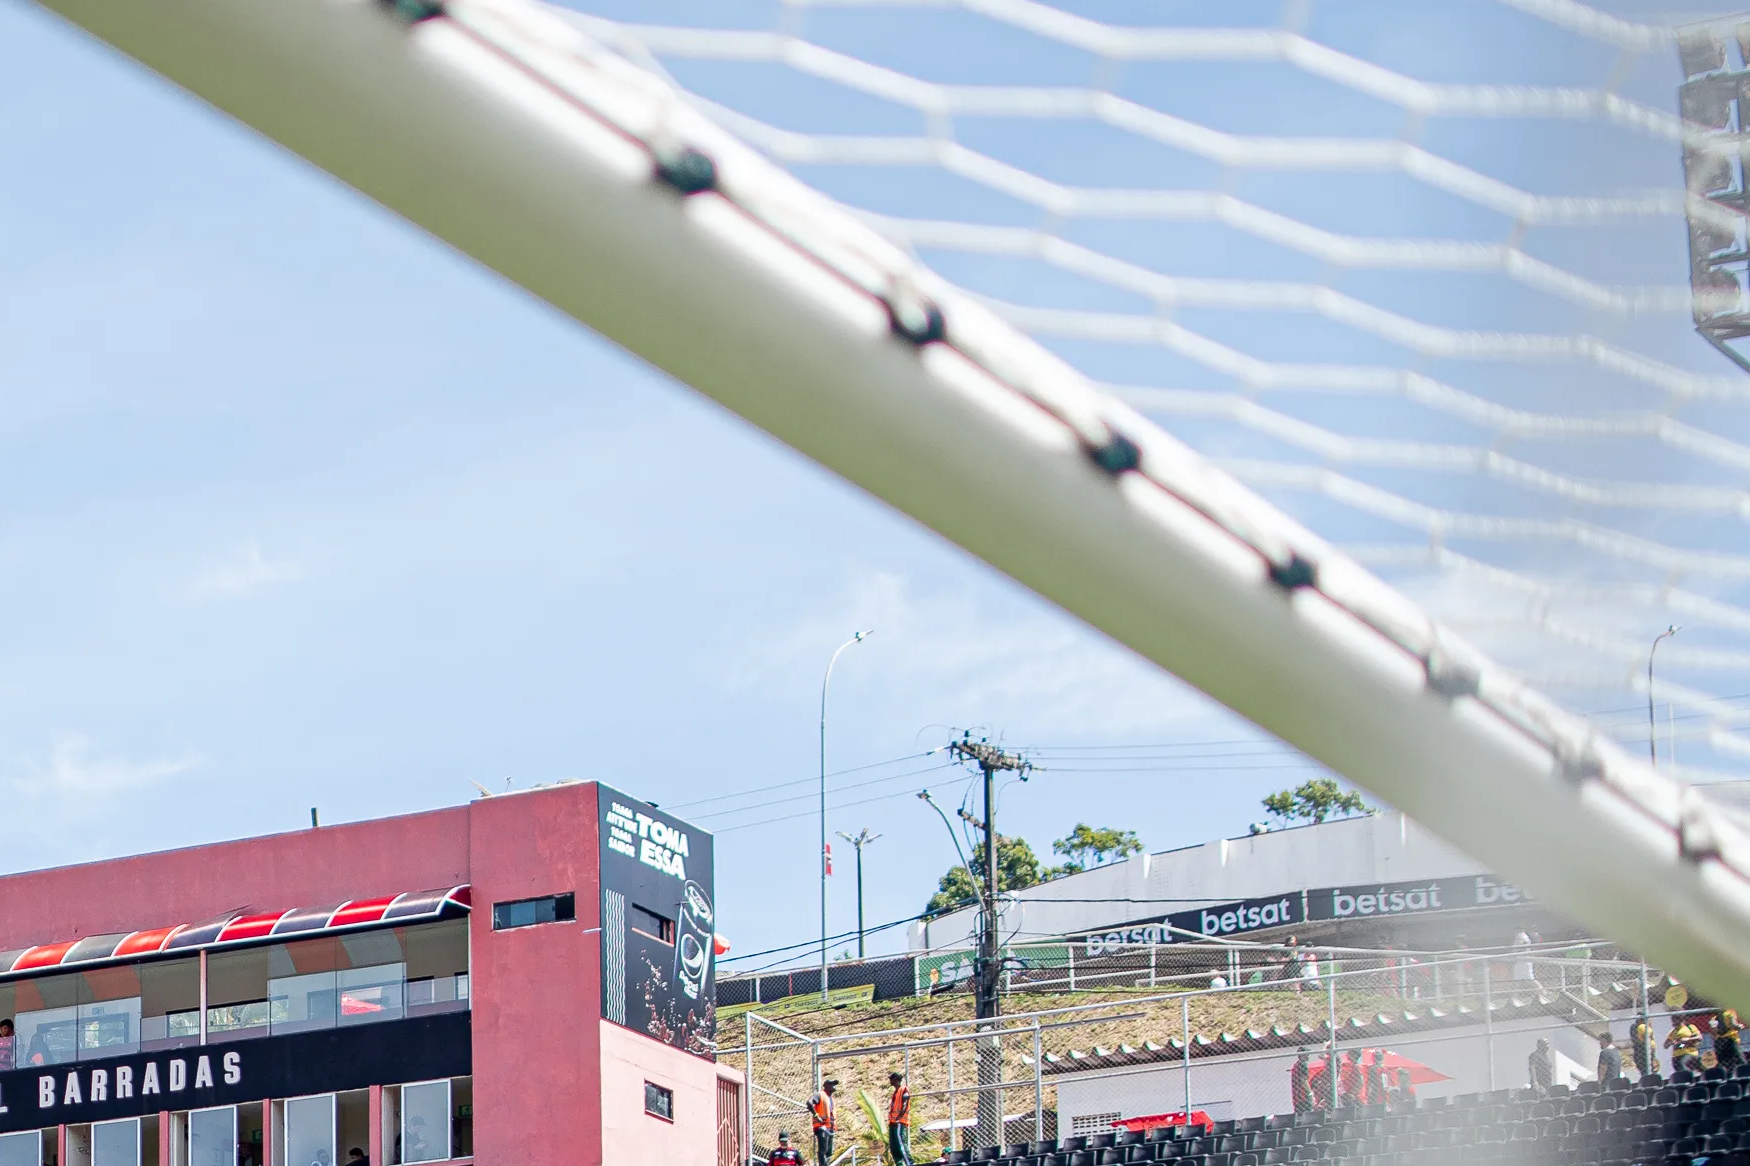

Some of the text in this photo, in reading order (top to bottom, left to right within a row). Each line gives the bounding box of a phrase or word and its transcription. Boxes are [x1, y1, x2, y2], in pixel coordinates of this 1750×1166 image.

[635, 813, 689, 857] TOMA
[639, 839, 686, 880] ESSA
[1201, 899, 1290, 936] betsat
[1334, 882, 1441, 916] betsat
[39, 1052, 241, 1108] BARRADAS
